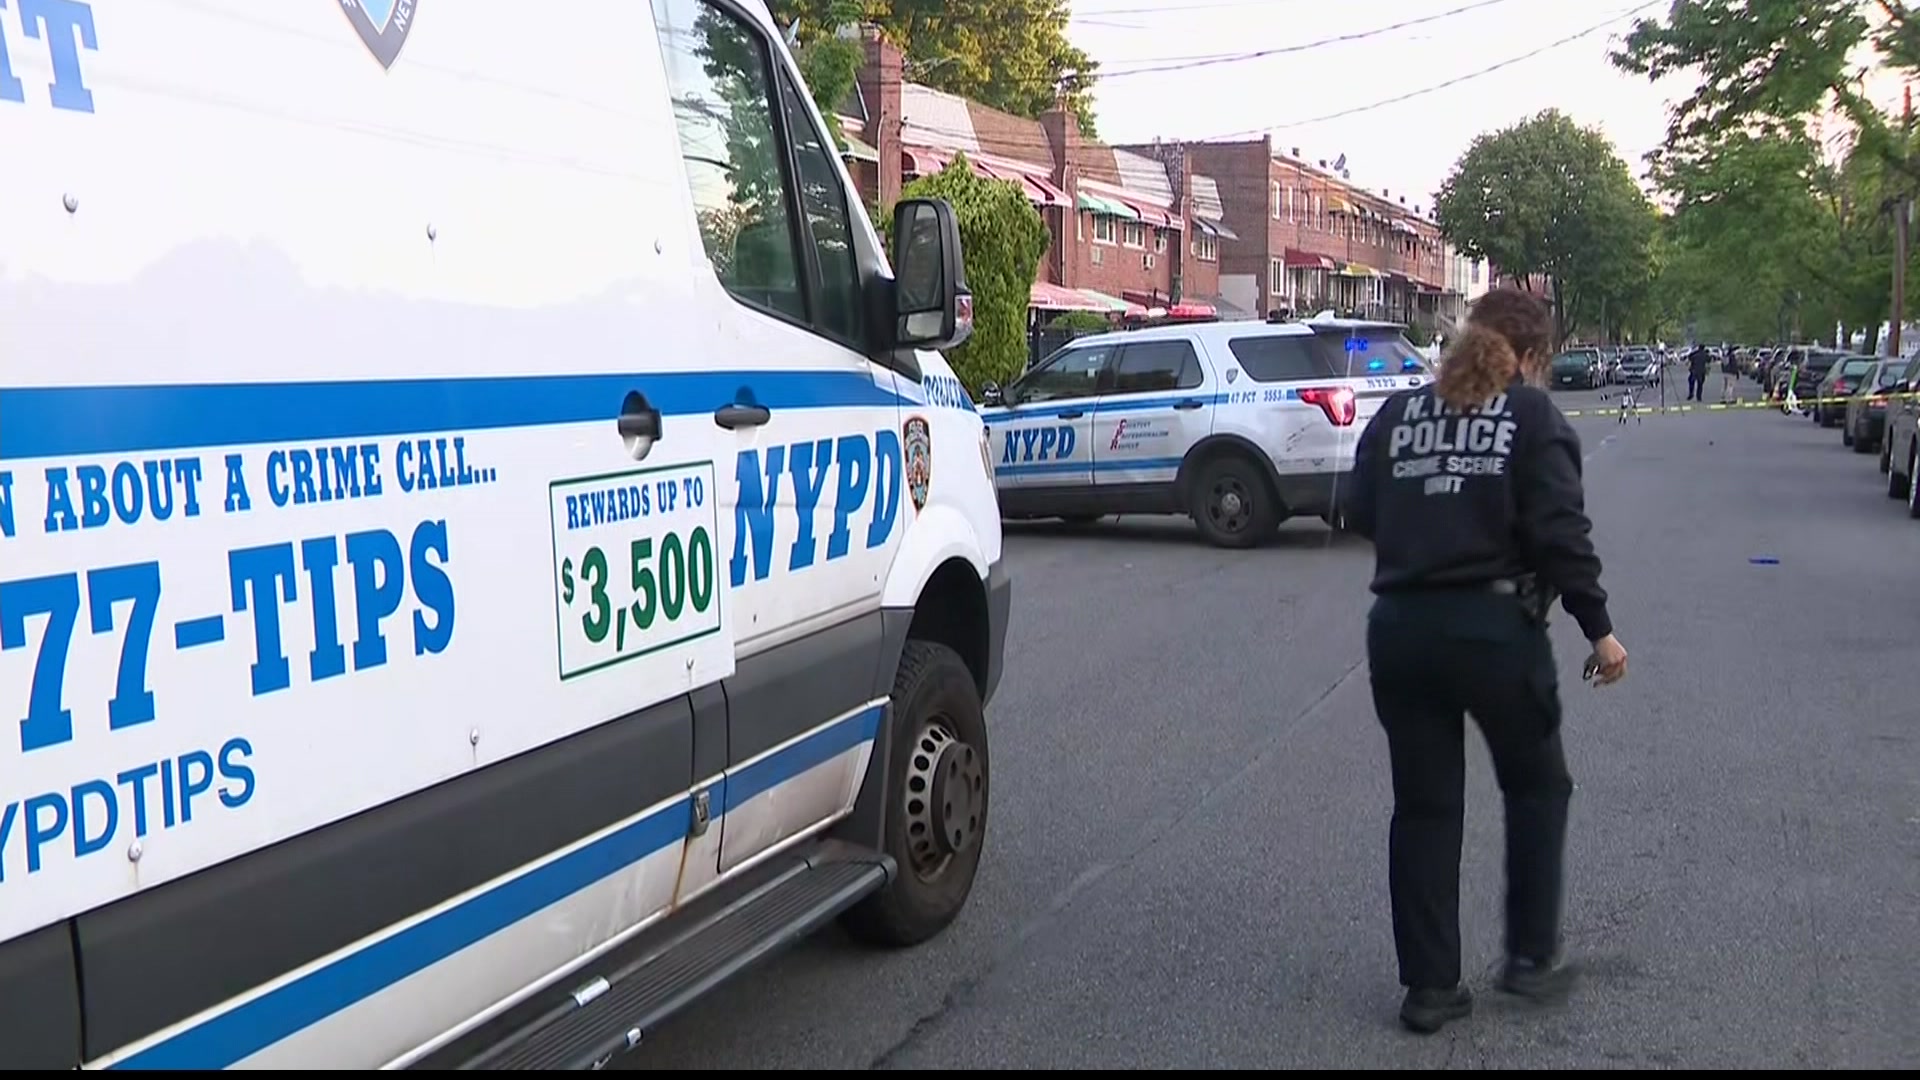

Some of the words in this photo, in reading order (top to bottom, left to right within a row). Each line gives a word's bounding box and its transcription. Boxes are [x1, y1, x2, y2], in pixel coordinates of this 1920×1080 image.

[1002, 425, 1075, 464] NYPD
[1389, 417, 1518, 457] POLICE
[44, 457, 202, 533] ABOUT
[224, 454, 251, 512] A
[266, 443, 382, 507] CRIME
[396, 437, 496, 493] CALL...
[1424, 475, 1465, 495] IT
[1446, 455, 1505, 474] SCENE
[566, 484, 650, 530] REWARDS
[656, 480, 677, 513] UP
[683, 476, 703, 507] TO
[729, 429, 900, 588] NYPD
[562, 525, 713, 652] $3,500
[0, 519, 456, 753] 77-TIPS
